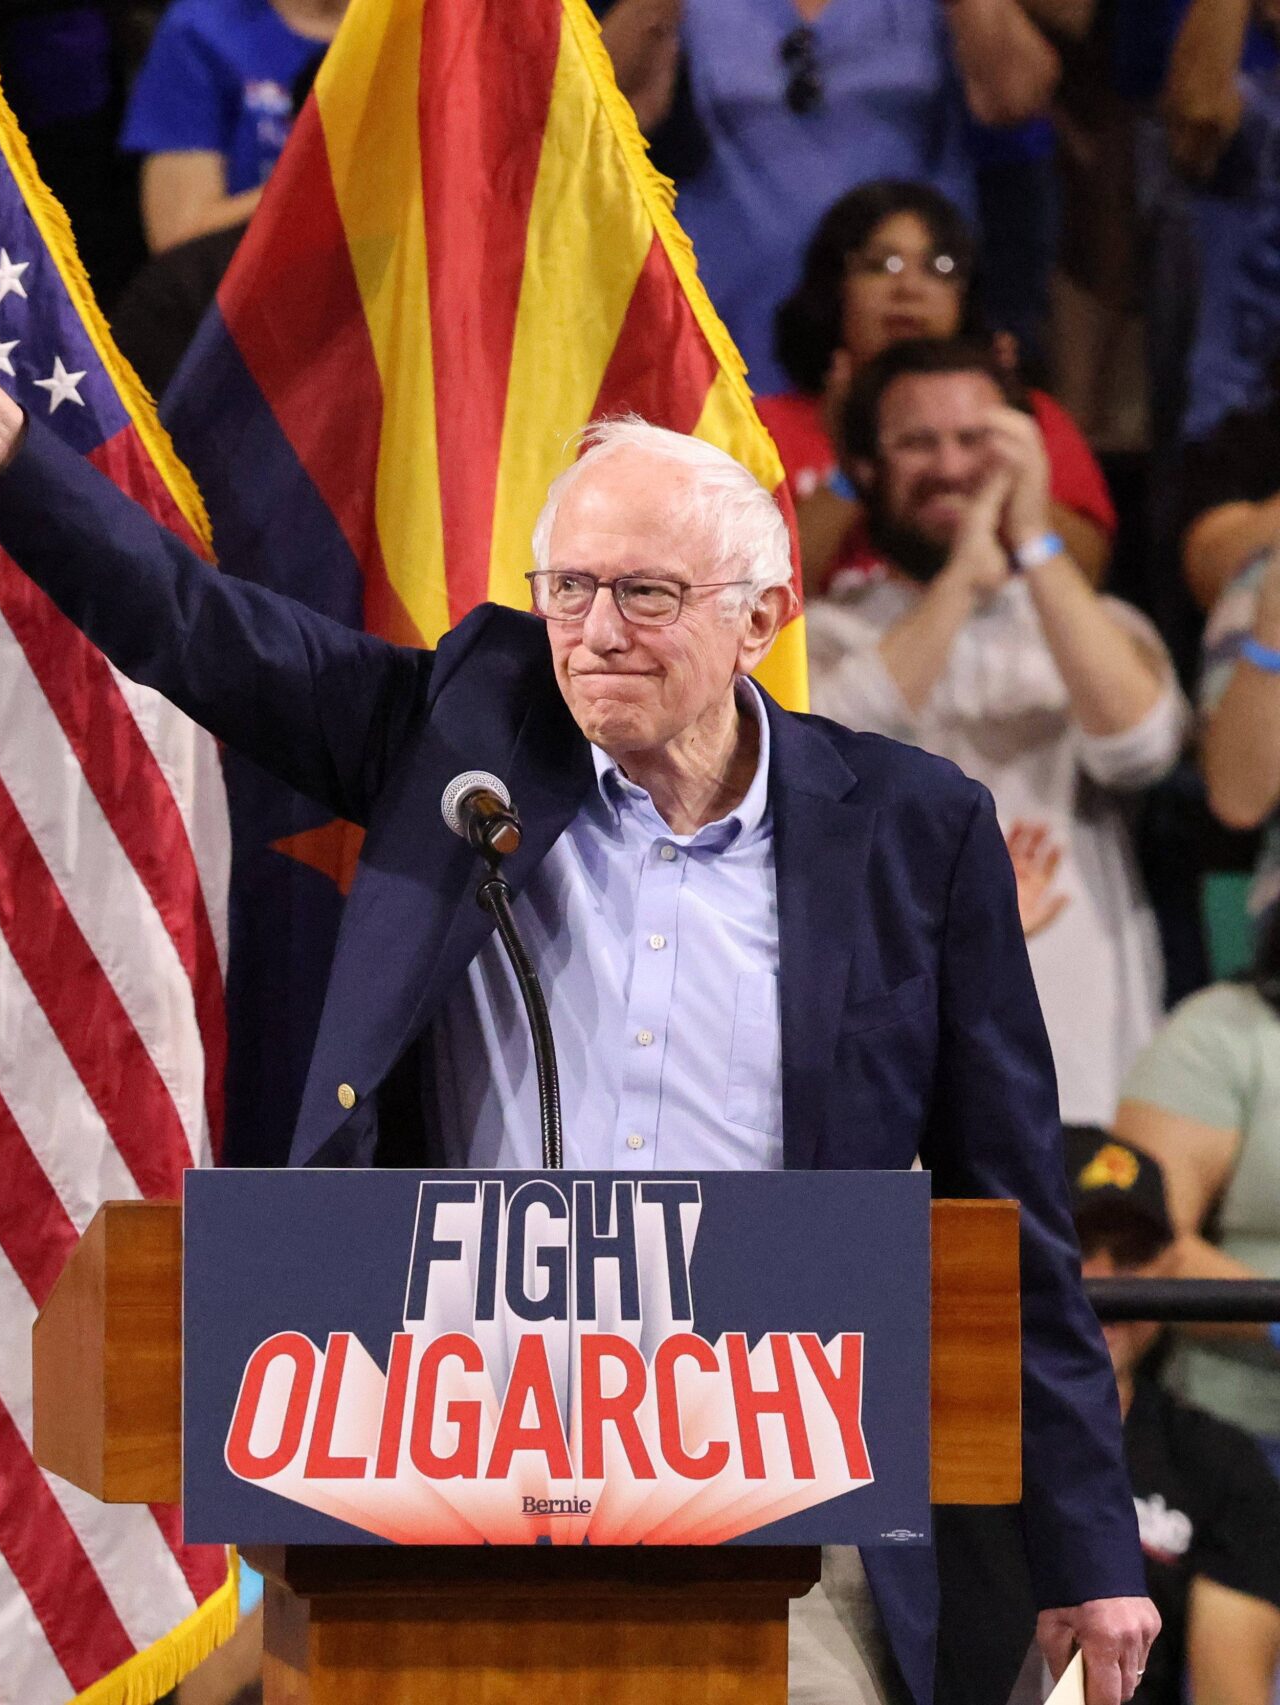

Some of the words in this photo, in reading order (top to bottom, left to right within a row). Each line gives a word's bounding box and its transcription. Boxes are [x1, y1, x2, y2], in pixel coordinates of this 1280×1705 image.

[403, 1179, 702, 1322] FIGHT
[224, 1331, 874, 1482] OLIGARCHY
[521, 1495, 592, 1514] Bernie
